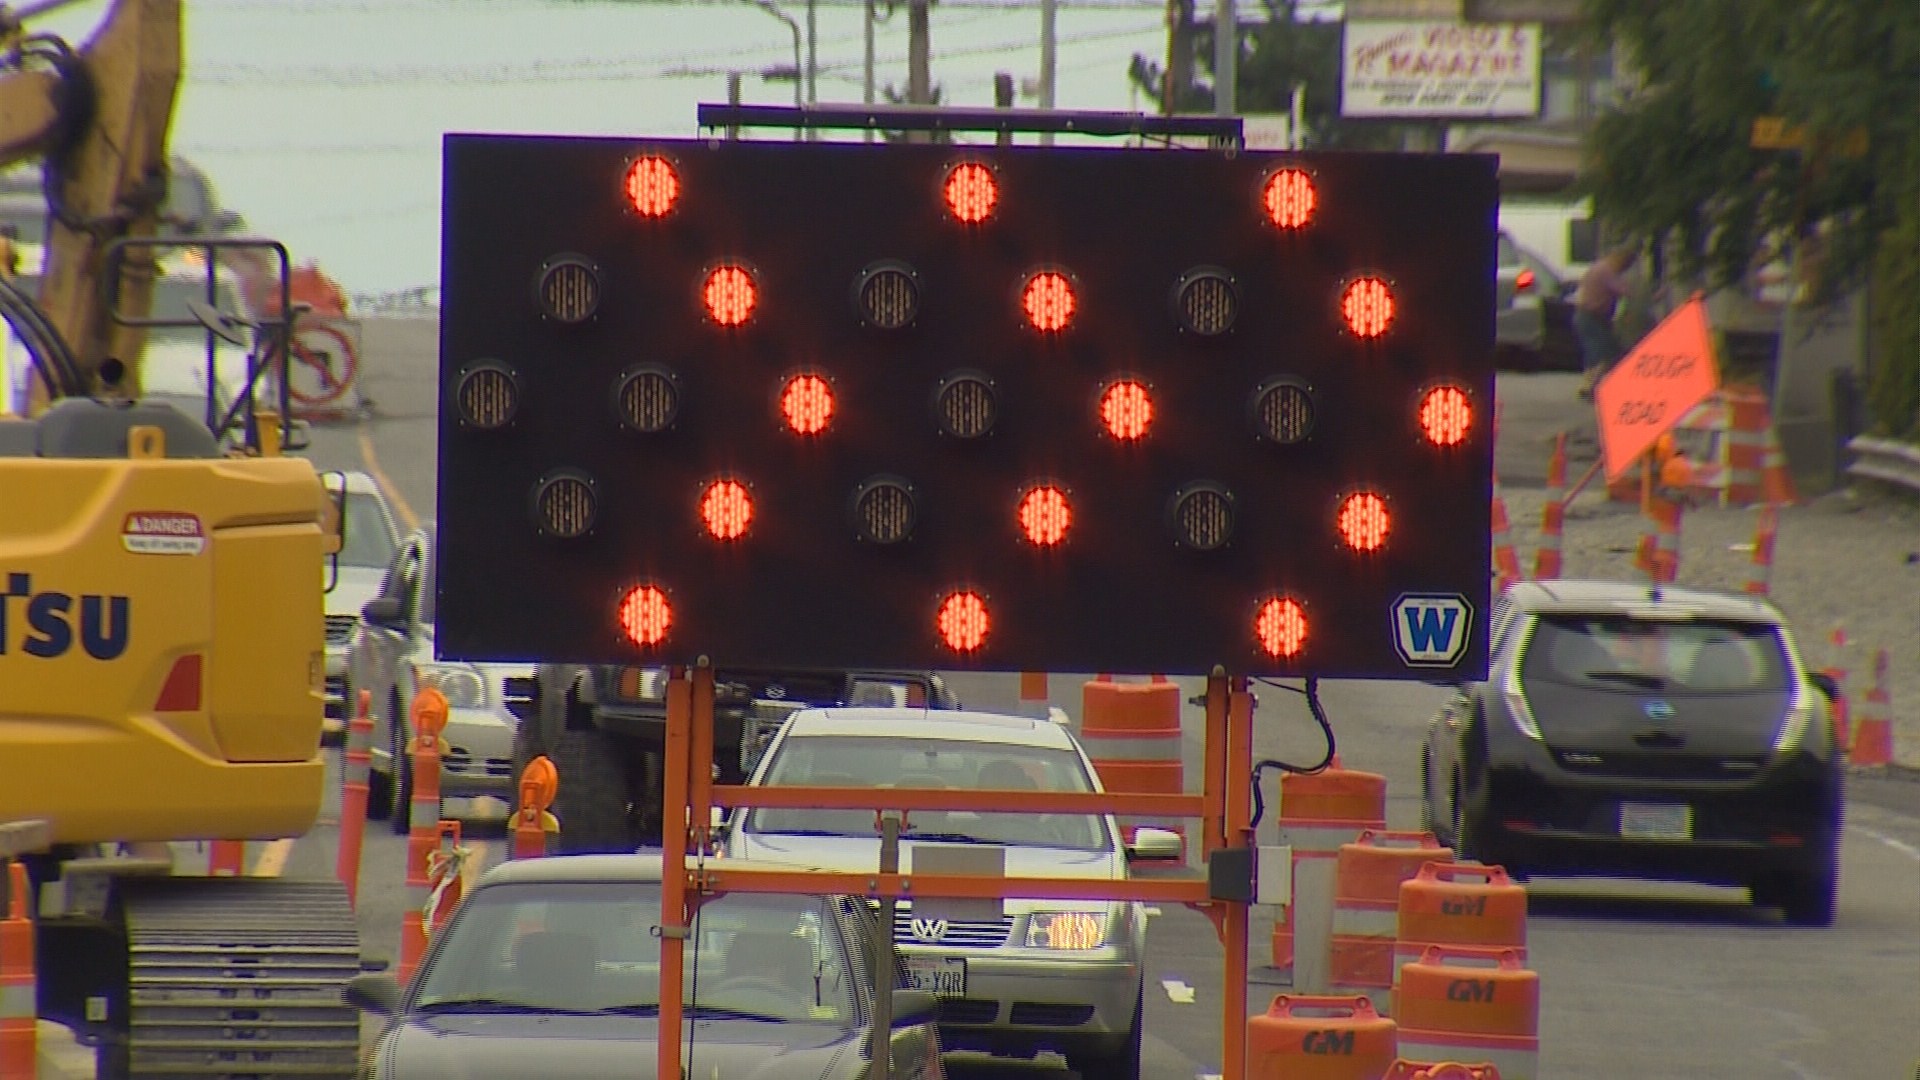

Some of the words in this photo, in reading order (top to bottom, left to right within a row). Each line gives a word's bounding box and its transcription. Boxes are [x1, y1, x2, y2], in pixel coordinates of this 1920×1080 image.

[1388, 50, 1524, 76] MAGAZINE
[1632, 353, 1698, 380] ROUGH
[1614, 400, 1667, 427] ROAD
[141, 516, 197, 534] DANGER
[1404, 607, 1459, 652] W
[1440, 895, 1487, 918] GM
[1447, 979, 1496, 1003] GM
[1301, 1029, 1356, 1056] GM
